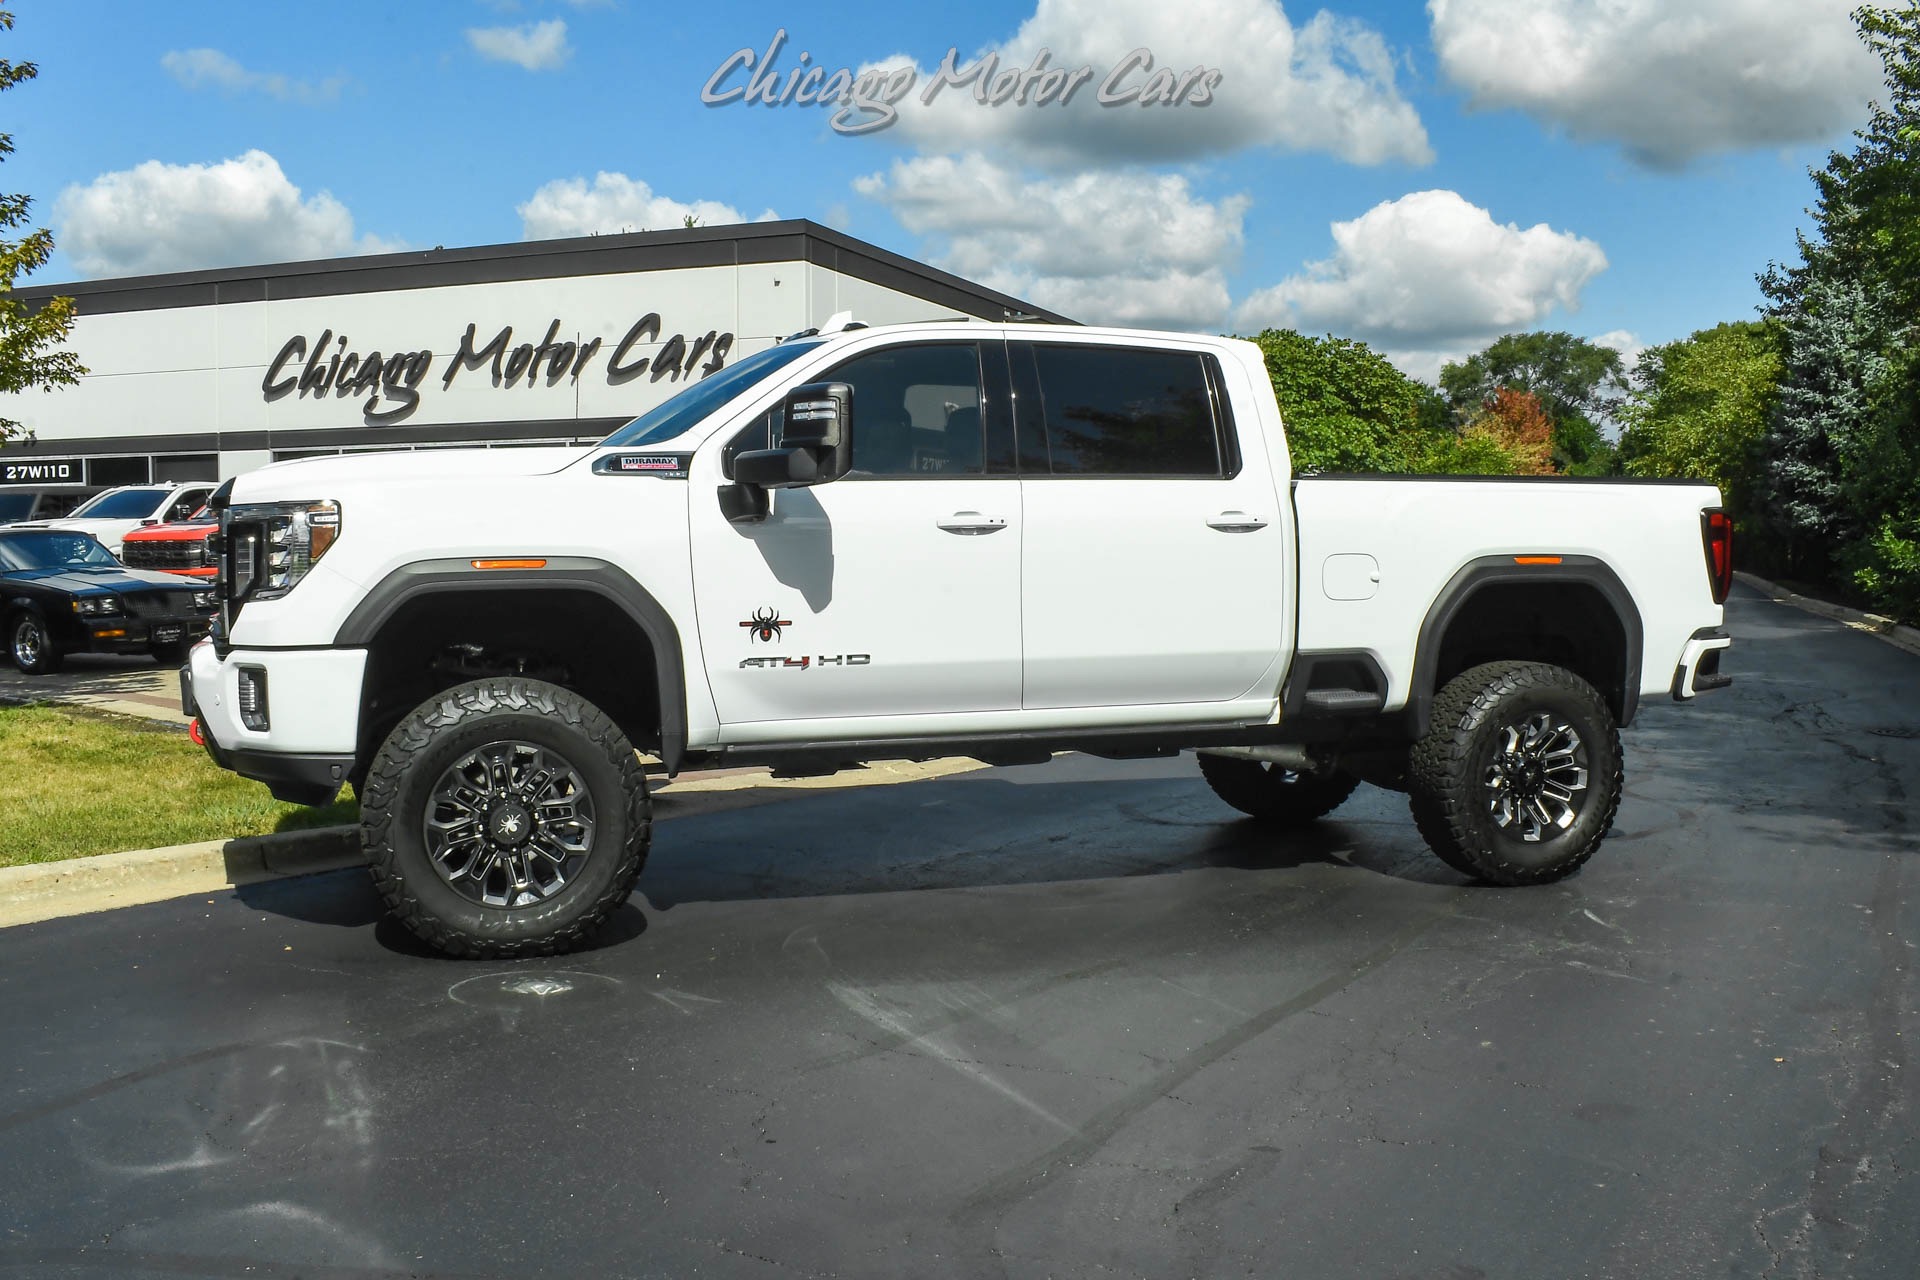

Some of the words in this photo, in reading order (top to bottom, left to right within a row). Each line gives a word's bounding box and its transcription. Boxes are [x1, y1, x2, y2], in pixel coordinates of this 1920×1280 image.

[262, 329, 433, 424] Chicago
[442, 318, 602, 390] Motor
[607, 312, 734, 384] Cars
[6, 464, 70, 479] 27W110
